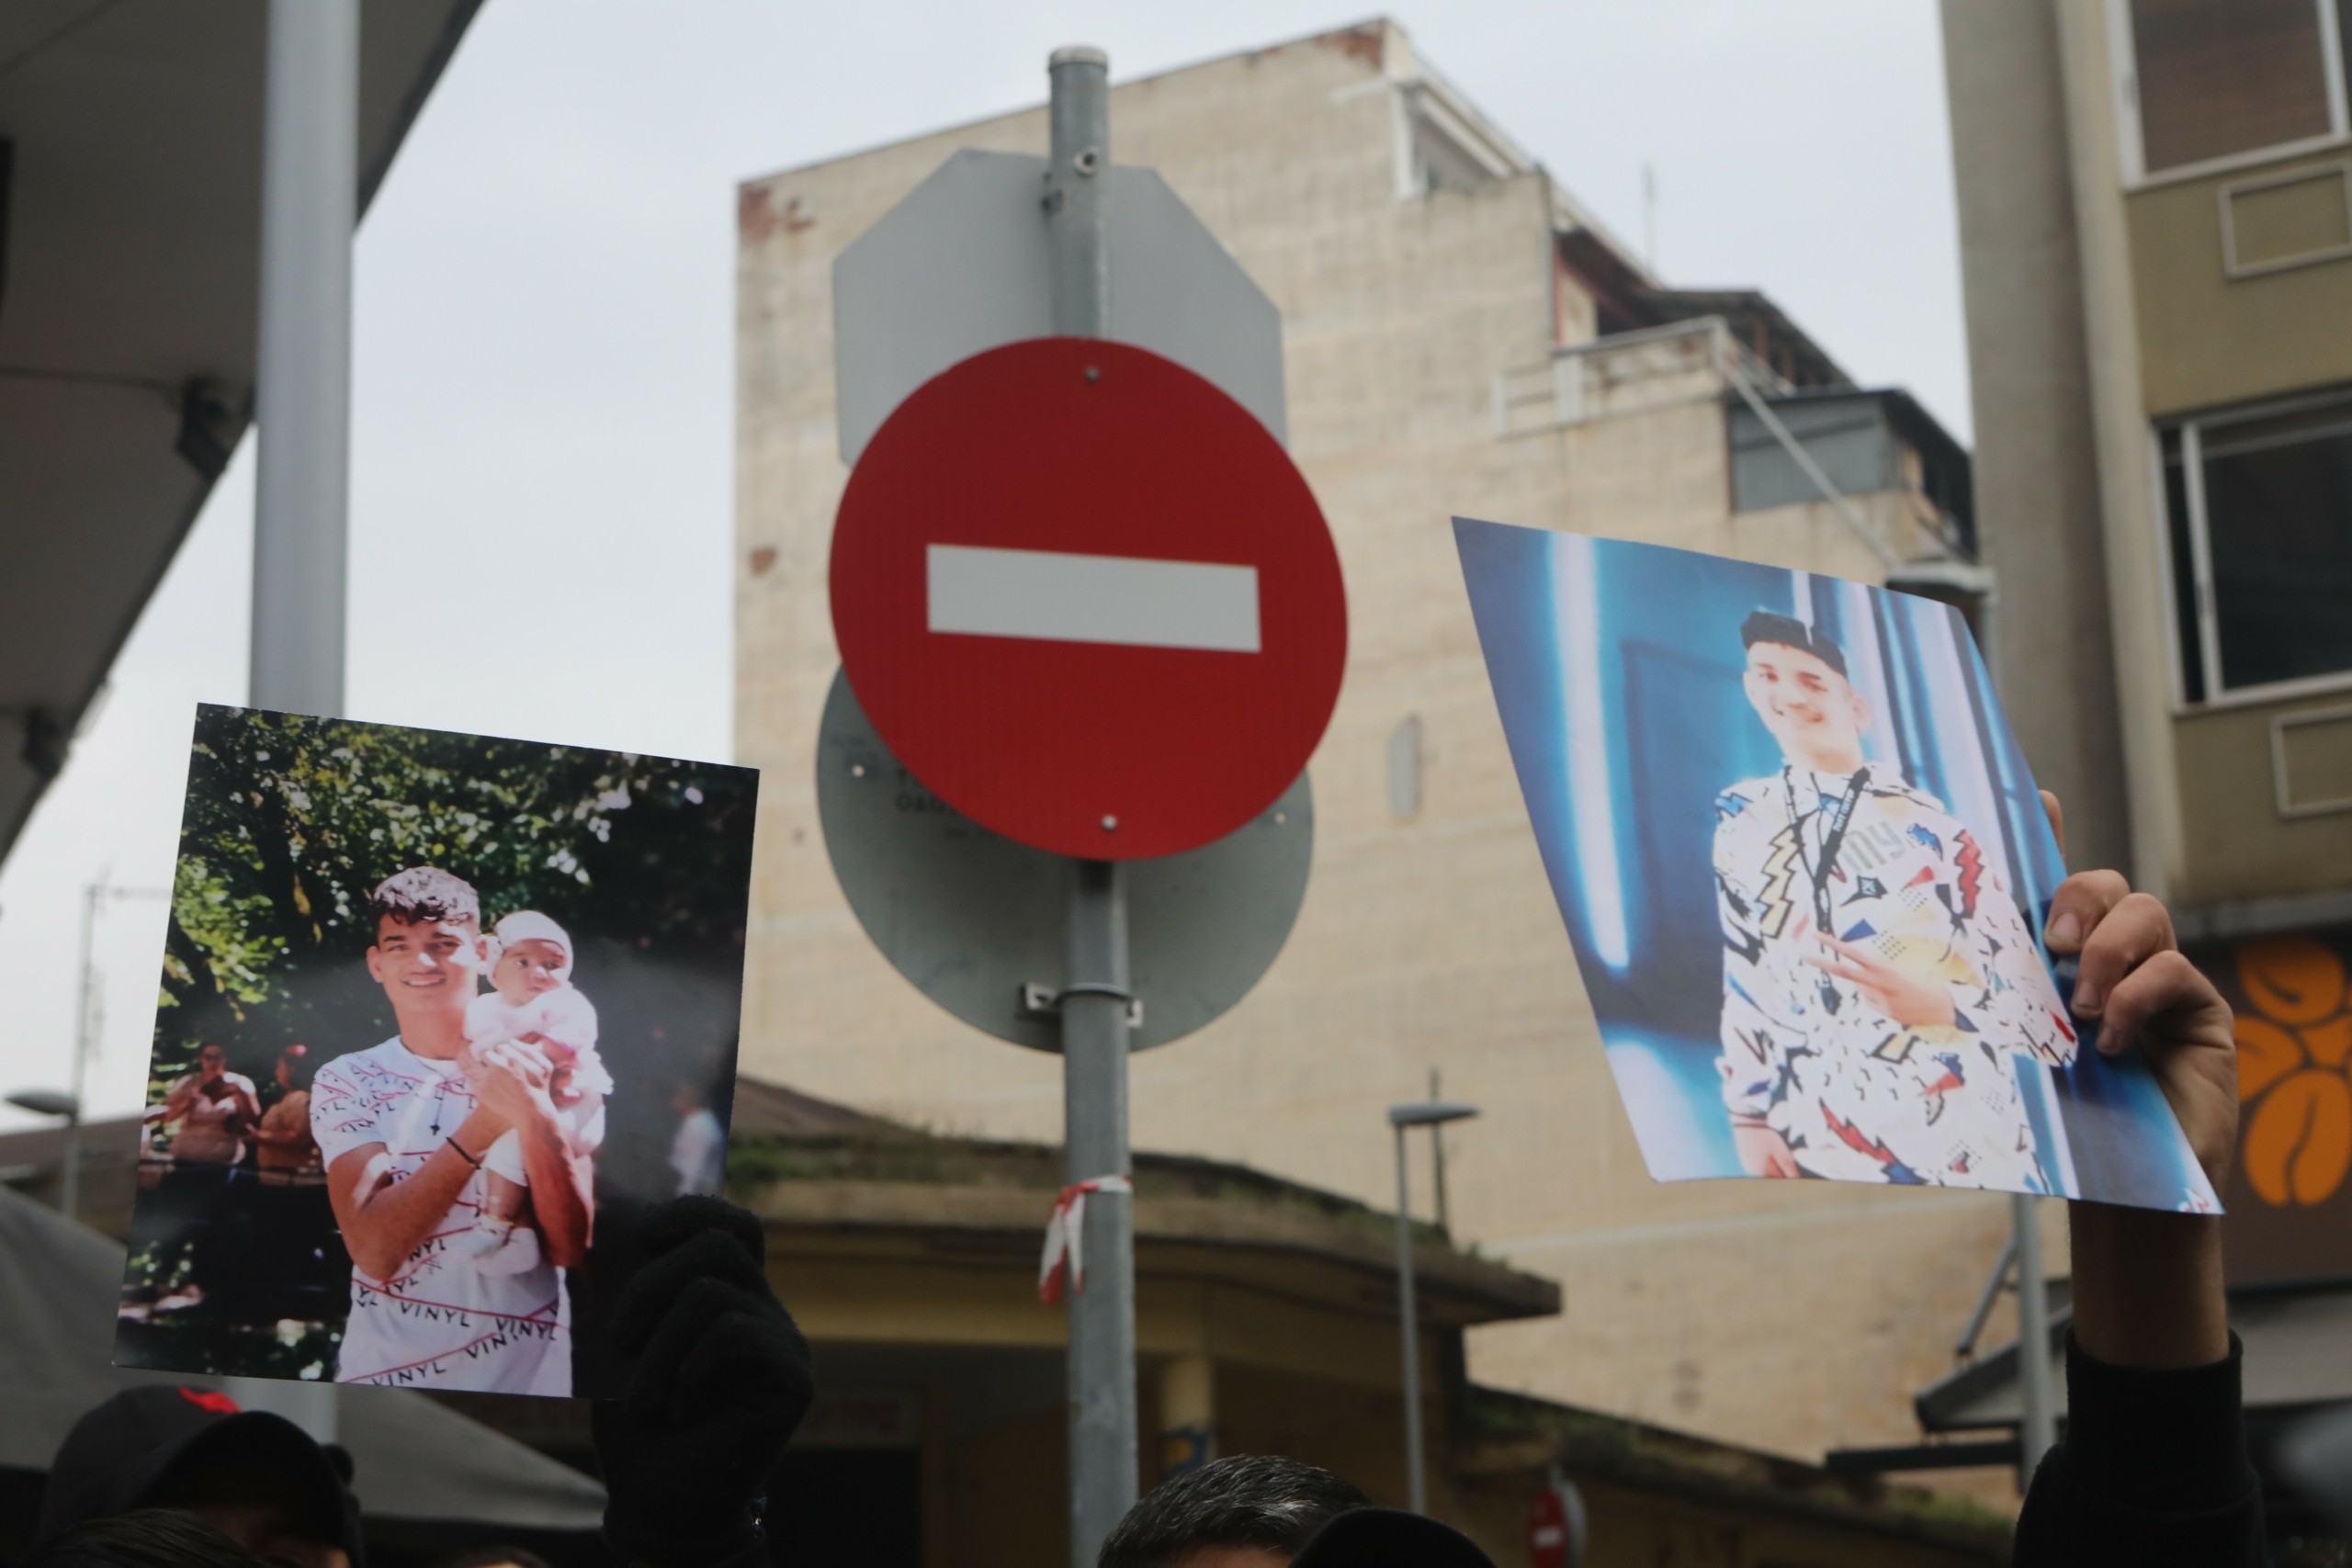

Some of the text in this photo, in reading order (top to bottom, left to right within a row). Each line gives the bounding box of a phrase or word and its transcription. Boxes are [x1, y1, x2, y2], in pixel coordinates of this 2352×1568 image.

[408, 1238, 447, 1262] NYL
[400, 1301, 557, 1341] VINYL VINYL
[371, 1332, 510, 1386] VINYL VIN
